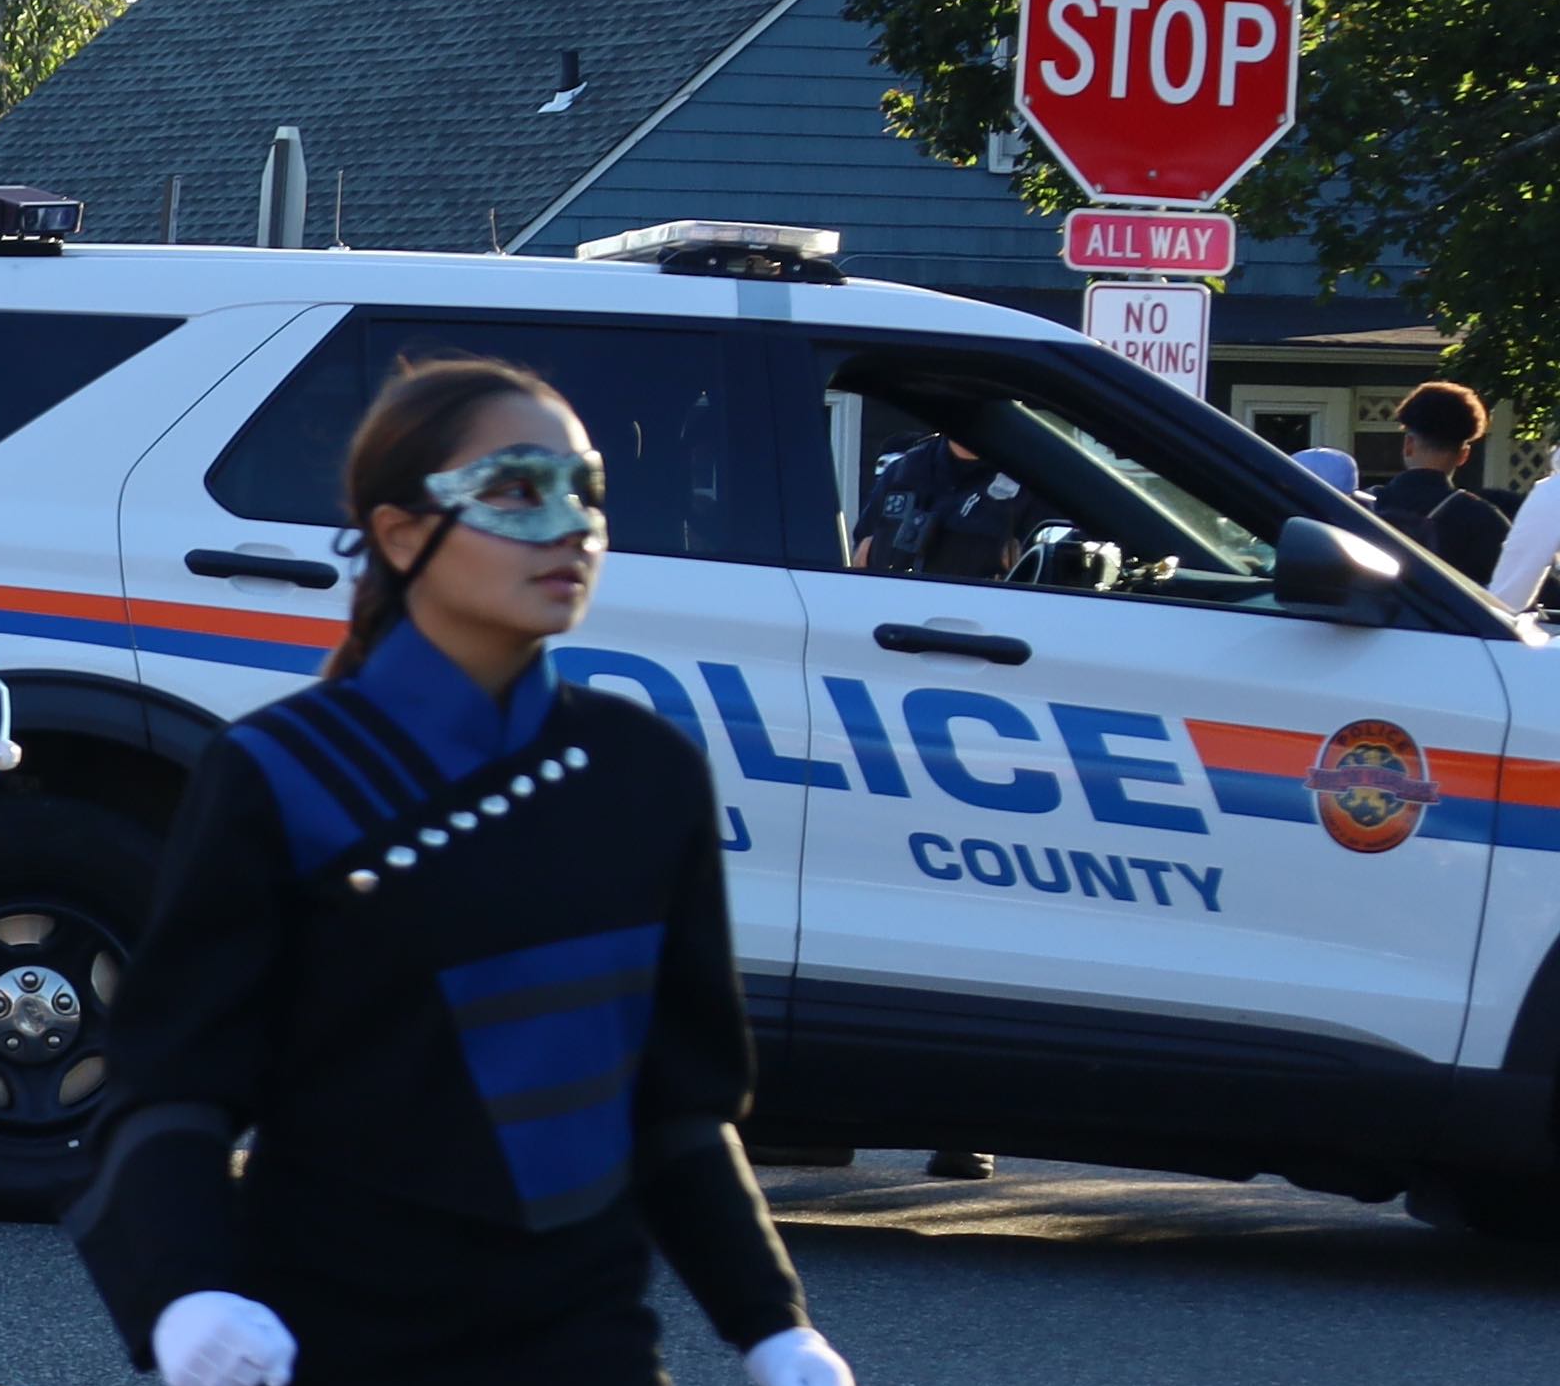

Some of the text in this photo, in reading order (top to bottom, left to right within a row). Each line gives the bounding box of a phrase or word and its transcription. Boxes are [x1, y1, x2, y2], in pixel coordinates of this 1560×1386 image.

[1085, 224, 1214, 261] ALL WAY
[1124, 301, 1168, 335] NO
[908, 831, 1223, 912] COUNTY
